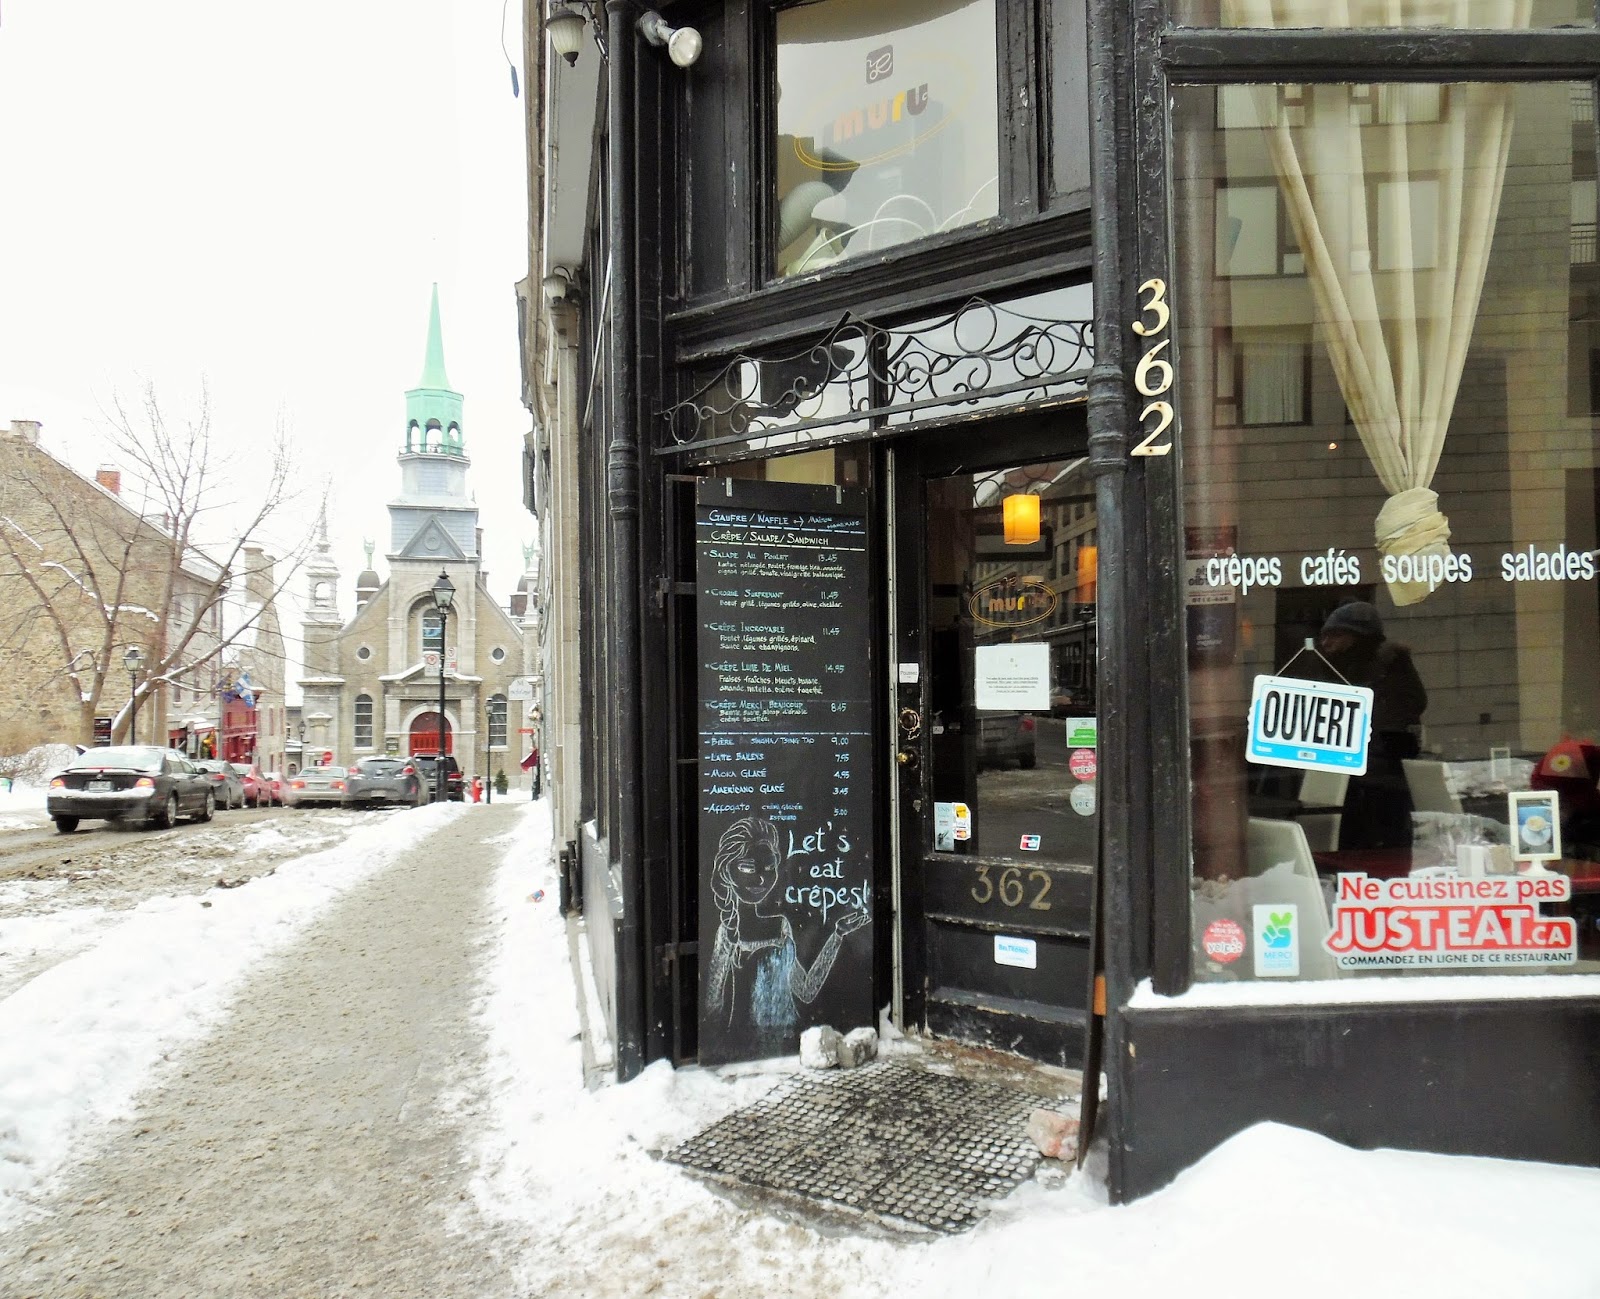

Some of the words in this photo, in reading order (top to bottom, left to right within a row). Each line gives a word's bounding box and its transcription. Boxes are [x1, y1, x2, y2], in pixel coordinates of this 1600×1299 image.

[833, 83, 928, 144] muru
[1130, 278, 1174, 456] 362
[708, 509, 747, 522] GAUFRE
[757, 514, 789, 525] WAFFLE
[787, 533, 829, 546] SANDWICH
[709, 550, 739, 559] SALADE
[1207, 552, 1282, 595] crêpes
[1301, 548, 1361, 586] cafés
[1383, 551, 1472, 592] soupes
[1501, 543, 1594, 582] salades
[739, 700, 763, 710] MERCI
[1262, 690, 1361, 748] OUVERT
[786, 821, 851, 859] Let's
[809, 857, 845, 879] eat
[971, 866, 1052, 911] 362
[1341, 877, 1380, 900] Ne
[1389, 877, 1508, 900] cuisinez
[1518, 880, 1565, 904] pas
[1341, 956, 1415, 965] COMMANDEZ
[1418, 955, 1433, 964] EN
[1437, 954, 1468, 964] LIGNE
[1472, 954, 1484, 963] DE
[1488, 954, 1501, 963] CE
[1505, 952, 1574, 962] RESTAURANT
